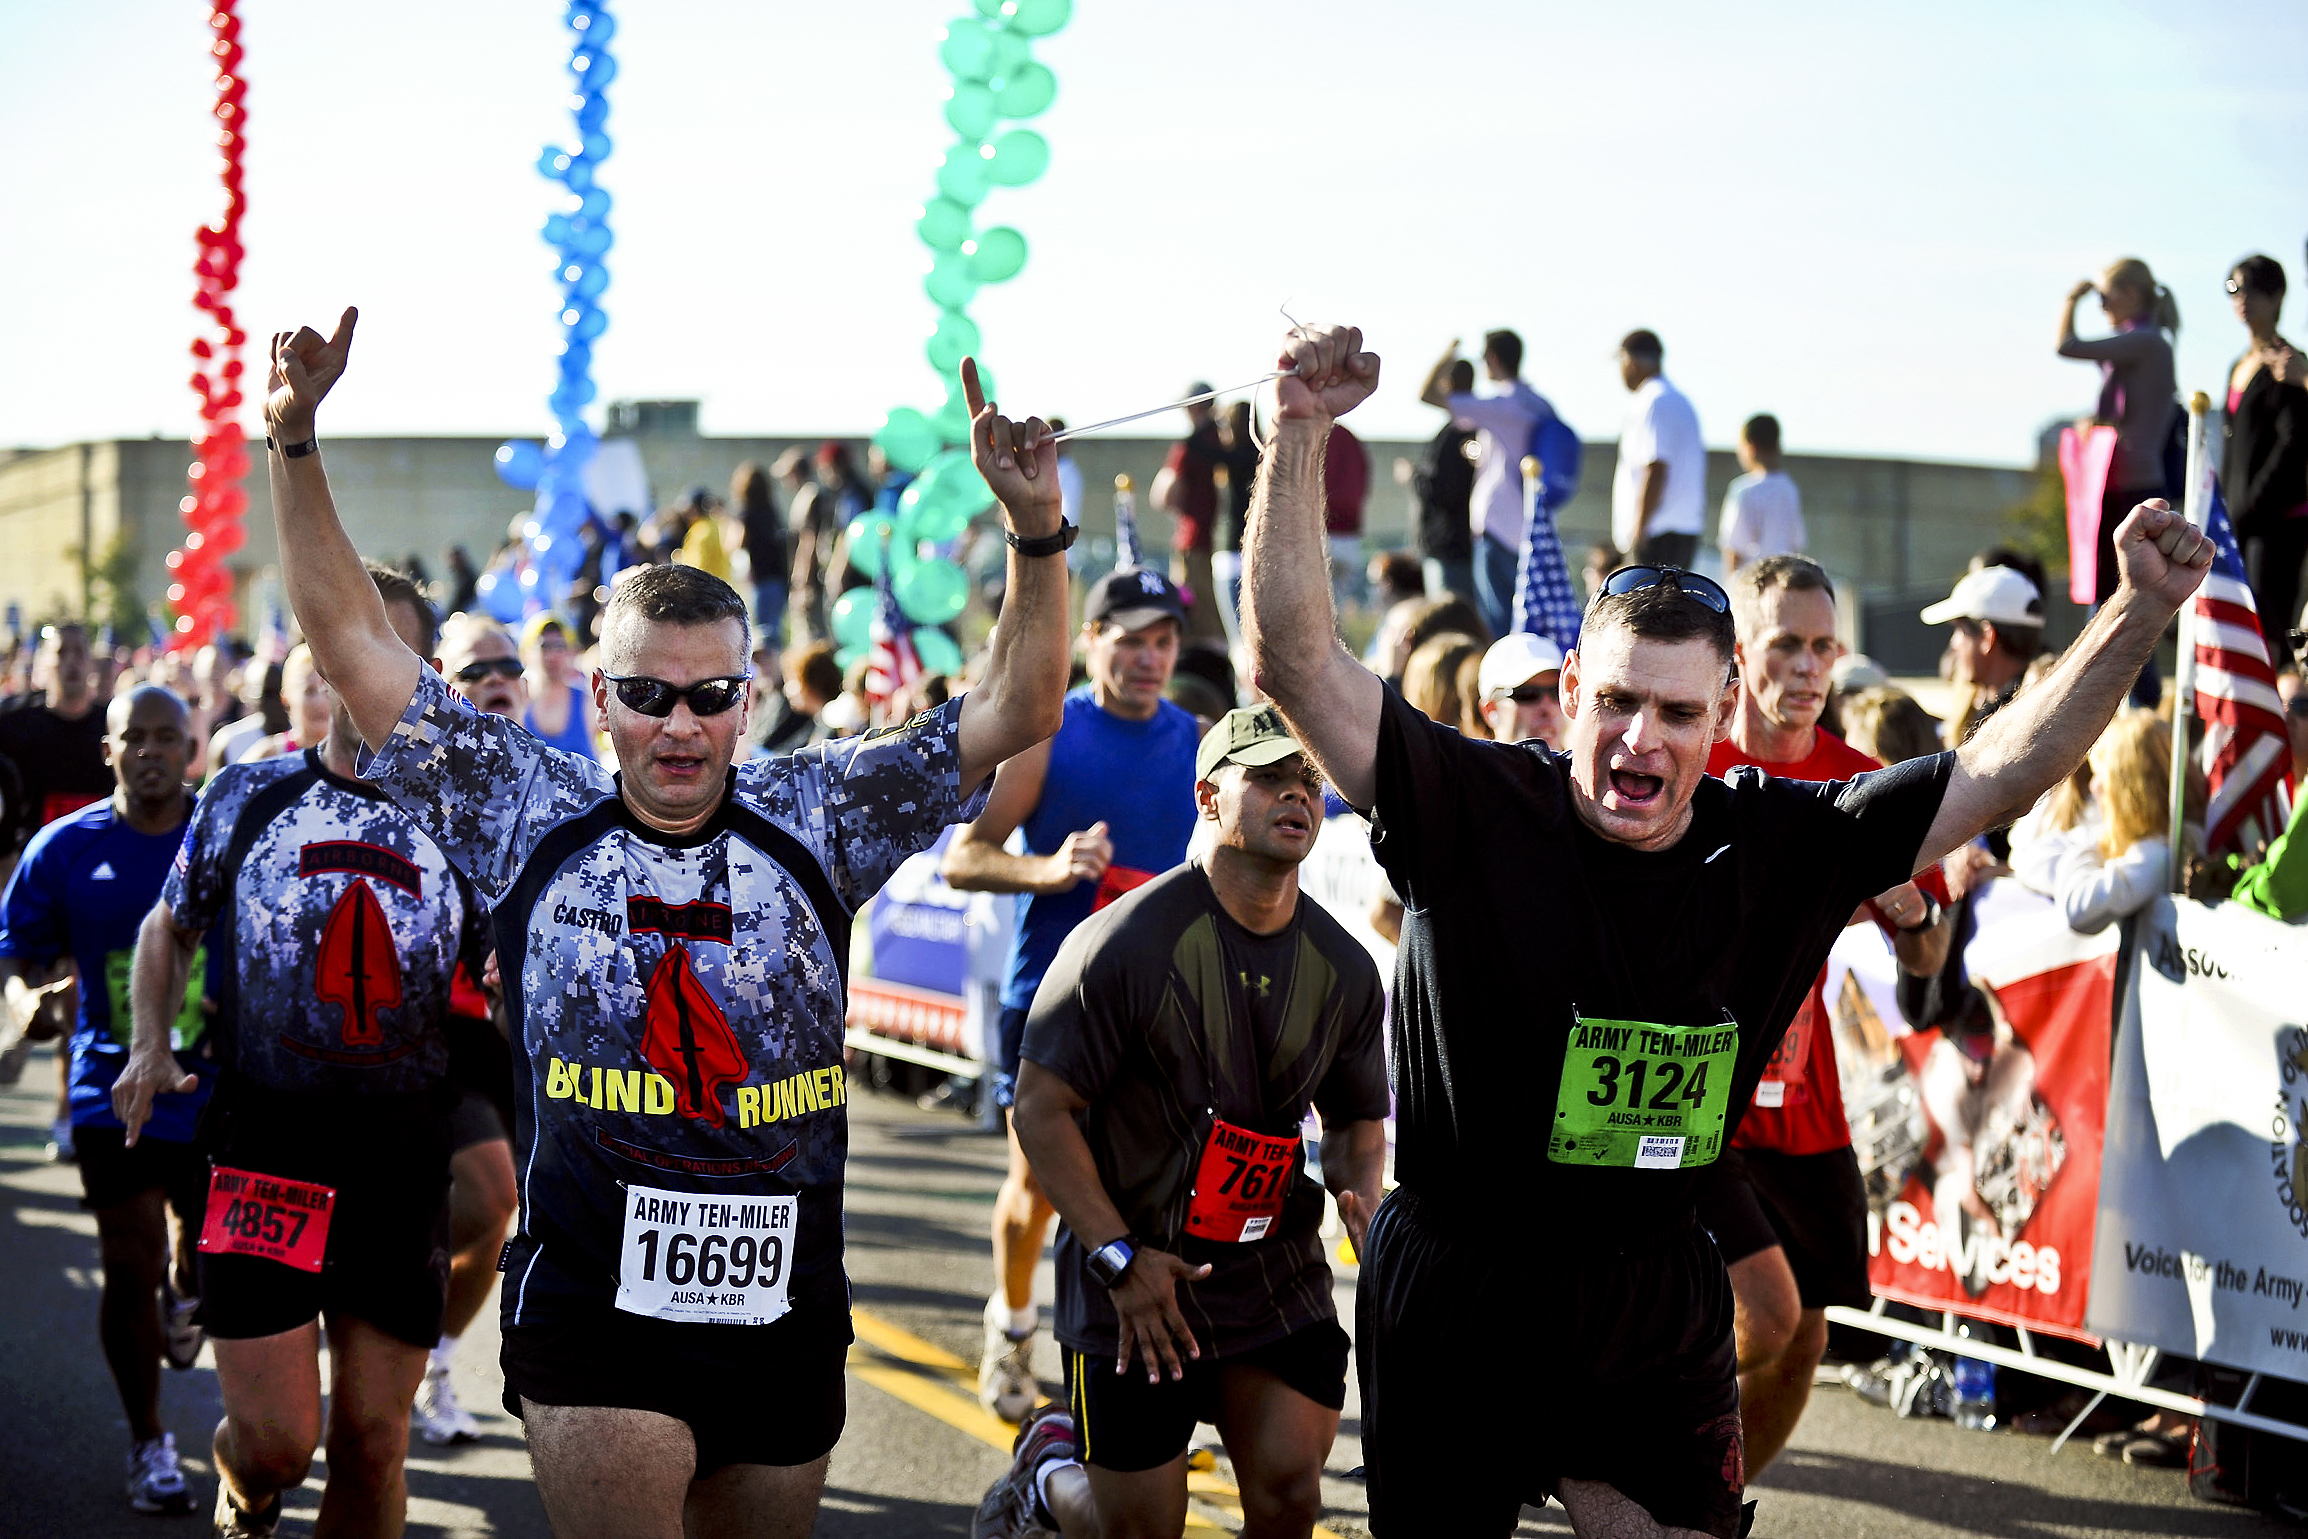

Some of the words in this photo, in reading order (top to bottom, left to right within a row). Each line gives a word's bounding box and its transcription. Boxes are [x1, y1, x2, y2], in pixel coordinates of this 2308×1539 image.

[553, 902, 623, 935] CASTRO
[1575, 1025, 1634, 1052] ARMY
[1639, 1029, 1734, 1058] TEN-MILER
[545, 1057, 675, 1116] BLIND
[736, 1064, 847, 1129] RUNNER
[1586, 1055, 1710, 1111] 3124
[1607, 1112, 1642, 1126] AUSA
[1656, 1113, 1683, 1127] KBR
[1213, 1129, 1261, 1158] ARMY
[213, 1173, 250, 1195] ARMY
[253, 1179, 330, 1211] TEN-MILER
[221, 1197, 310, 1249] 4857
[633, 1195, 692, 1227] ARMY
[697, 1202, 790, 1230] TEN-MILER
[636, 1228, 784, 1289] 16699
[1887, 1199, 2062, 1296] Services
[2124, 1240, 2185, 1280] Voice
[2188, 1252, 2211, 1283] for
[2216, 1258, 2248, 1293] the
[2253, 1266, 2304, 1310] Army
[670, 1291, 705, 1306] AUSA
[720, 1293, 746, 1307] KBR
